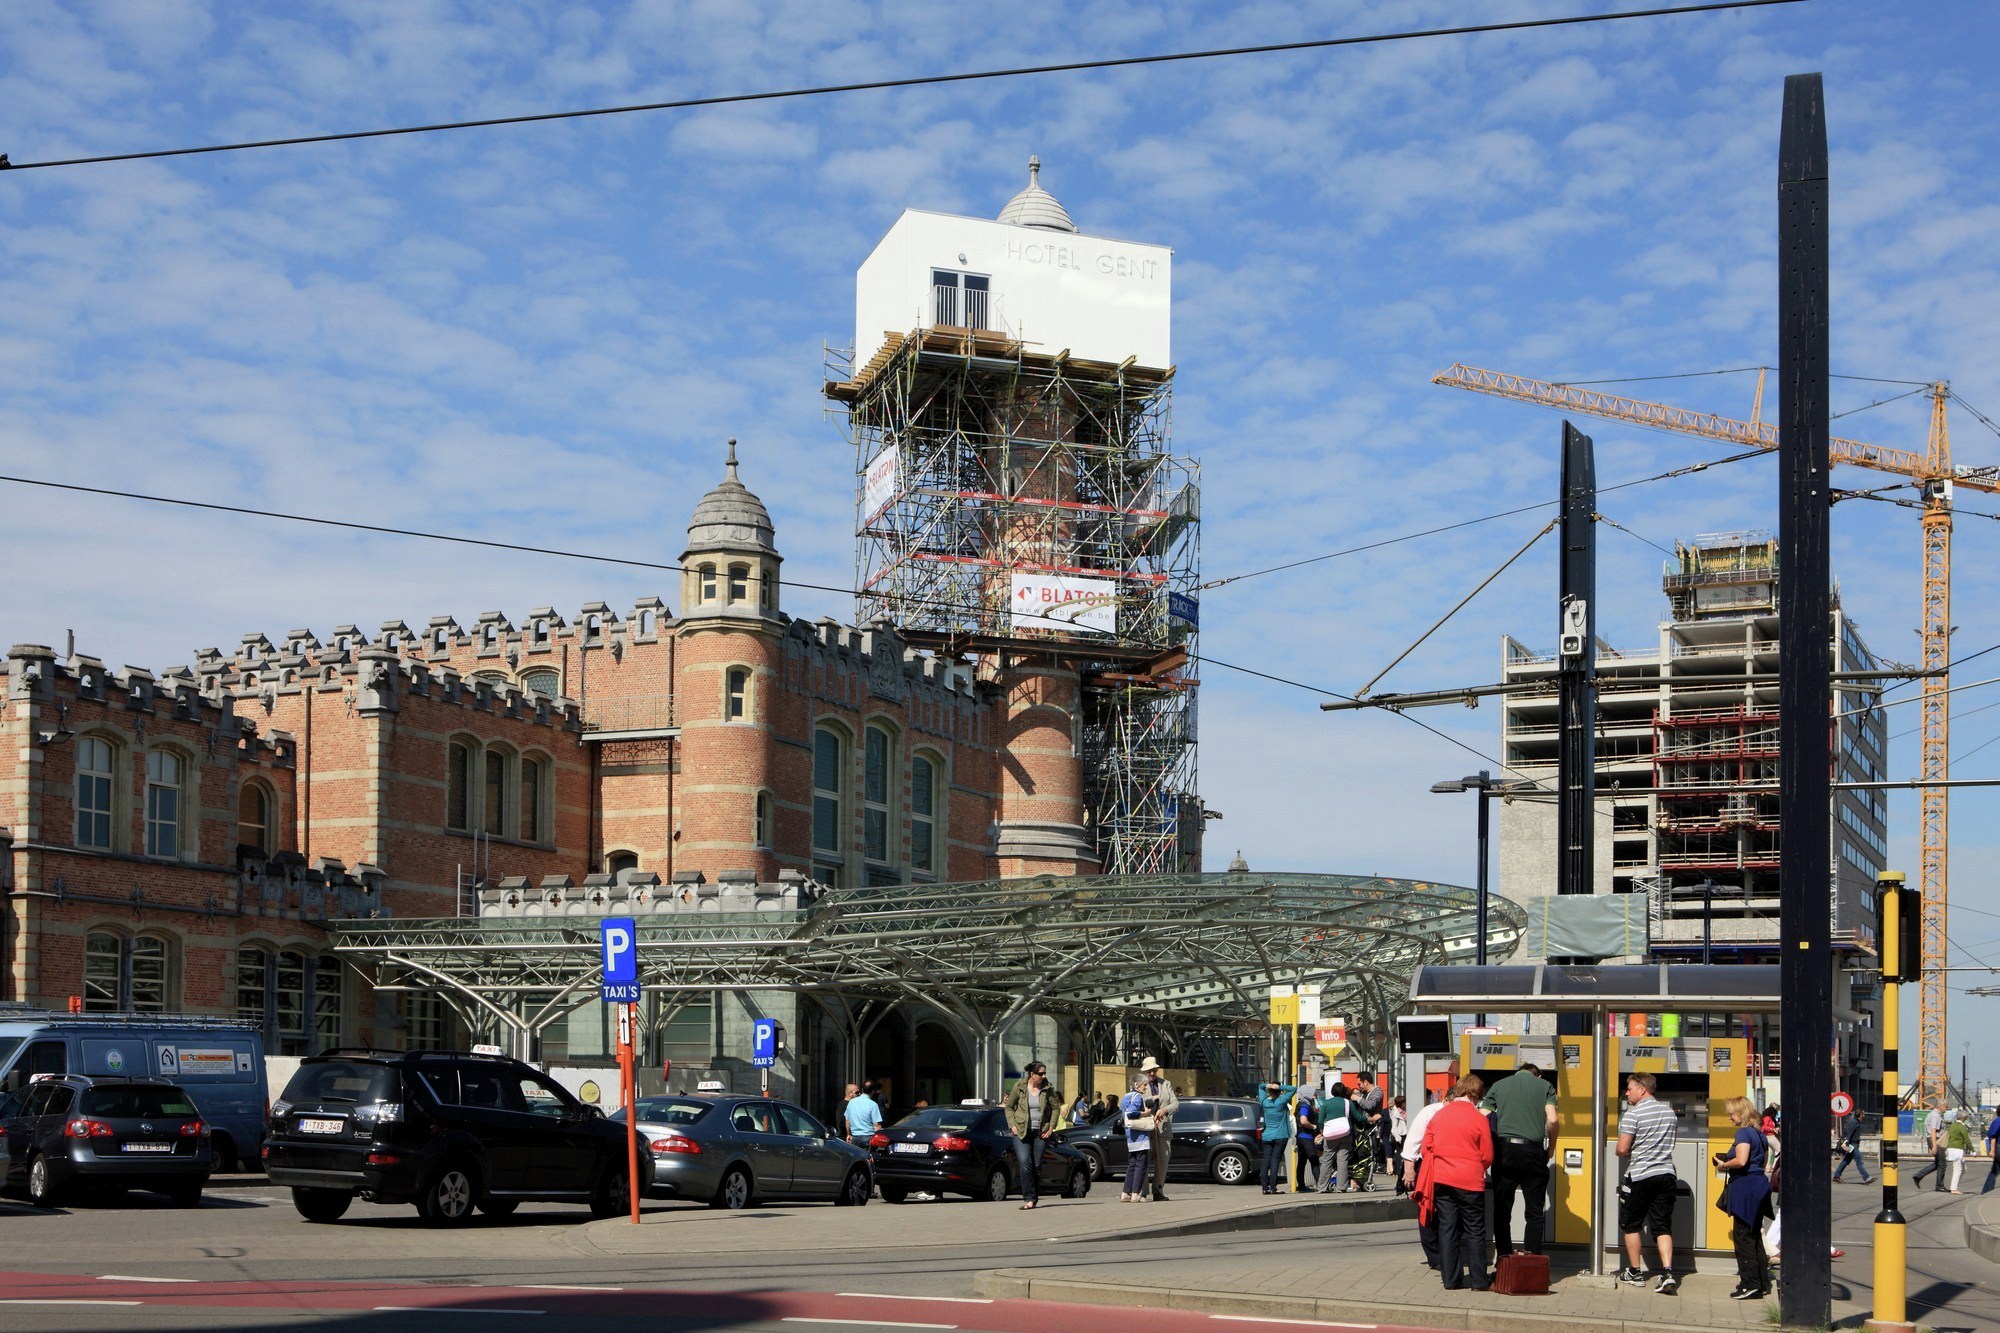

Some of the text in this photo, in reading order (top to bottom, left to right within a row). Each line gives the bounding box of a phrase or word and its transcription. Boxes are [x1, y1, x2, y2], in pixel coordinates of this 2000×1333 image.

[1008, 241, 1157, 279] HOTEL GENT
[1041, 587, 1110, 607] BLATON
[606, 928, 629, 971] P
[1276, 1004, 1287, 1014] 17
[756, 1024, 771, 1050] P
[1321, 1031, 1340, 1040] Info
[305, 1121, 342, 1131] 1-TXB-346
